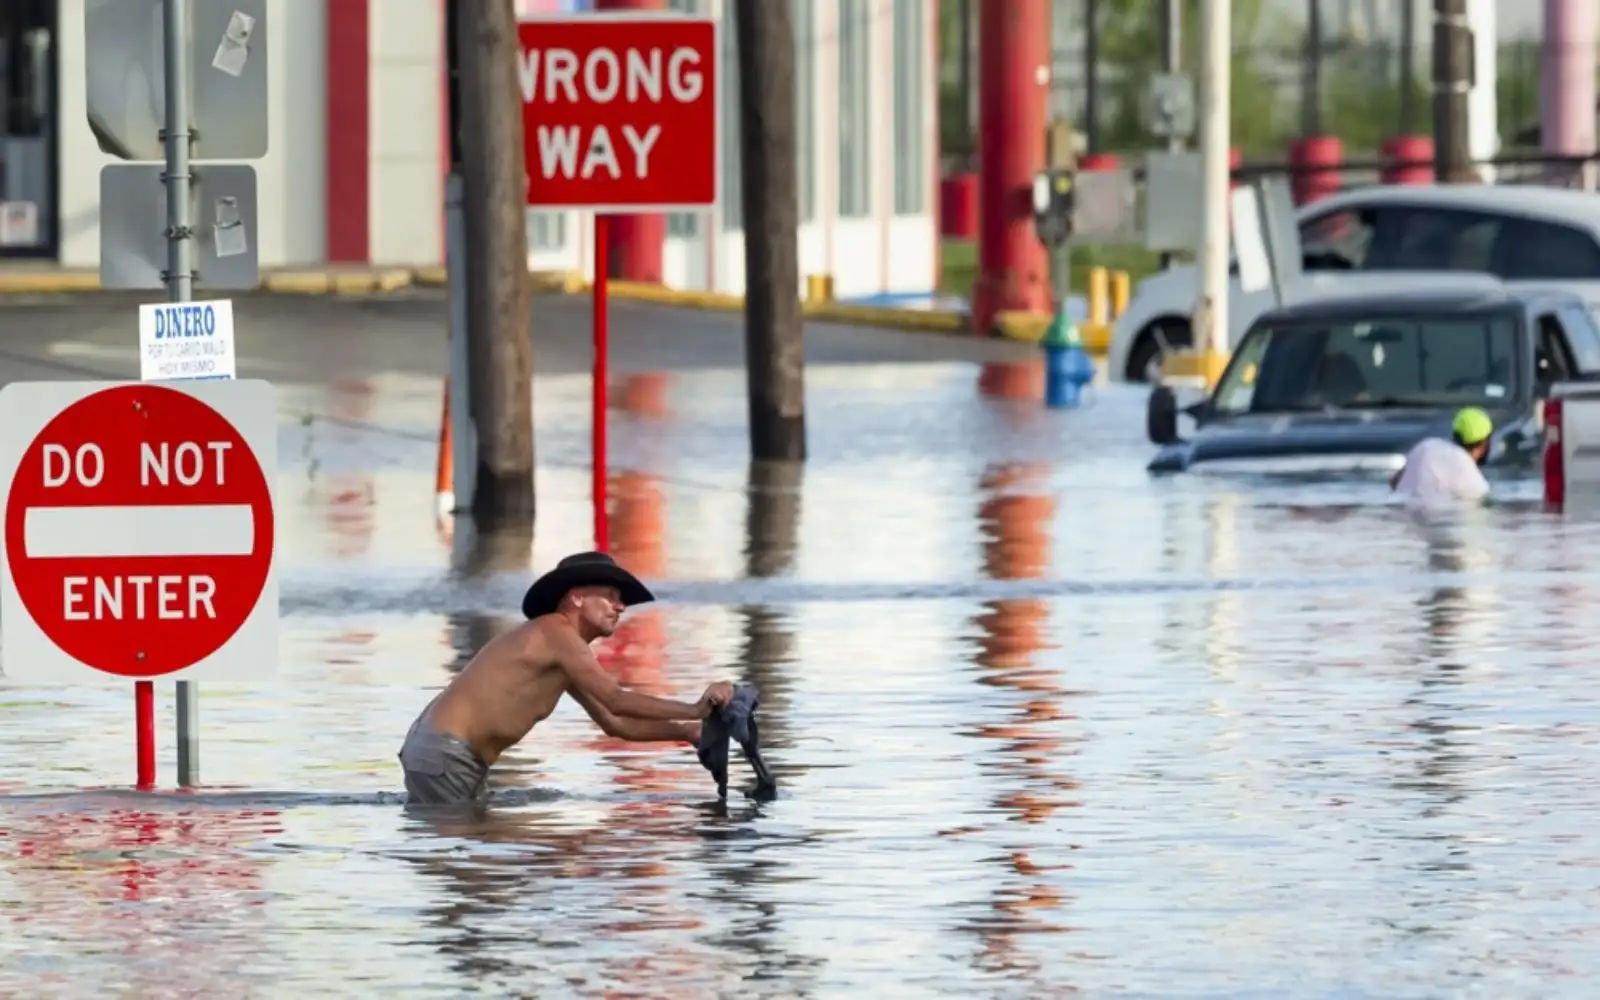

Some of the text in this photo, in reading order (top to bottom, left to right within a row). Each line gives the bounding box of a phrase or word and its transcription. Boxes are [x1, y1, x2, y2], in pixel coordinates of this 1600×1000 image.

[537, 124, 662, 180] WAY
[155, 304, 215, 339] DINERO
[42, 440, 233, 488] DO NOT
[63, 575, 217, 621] ENTER
